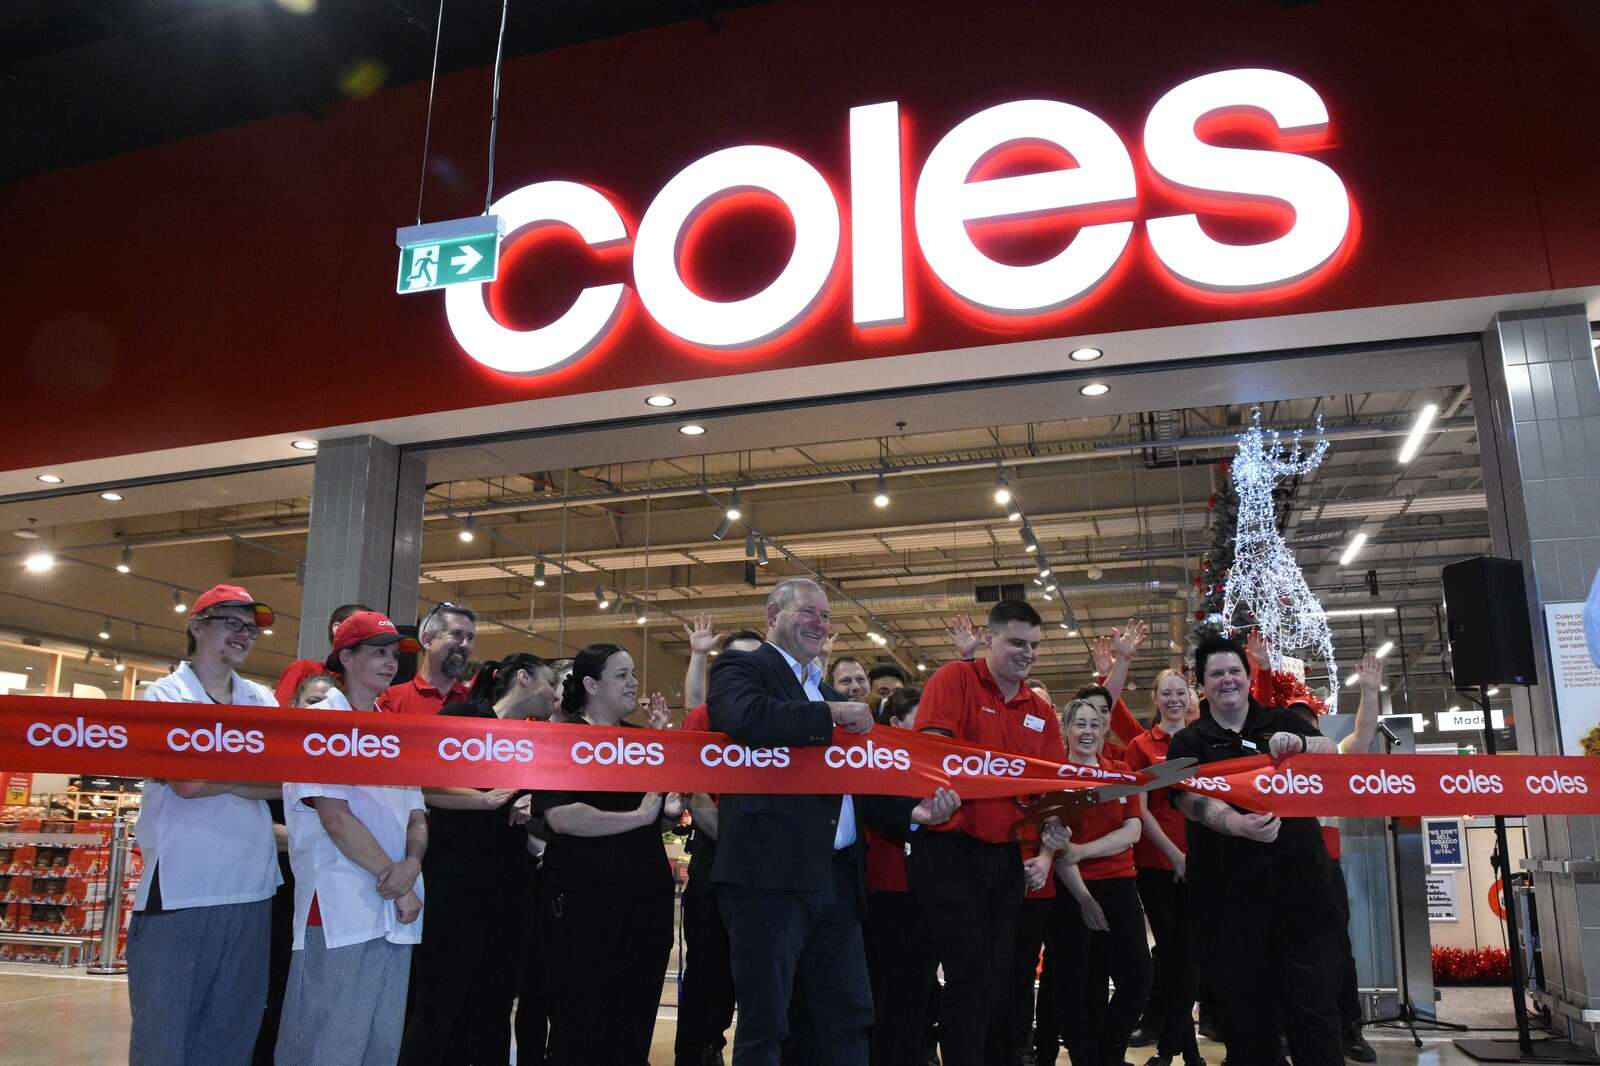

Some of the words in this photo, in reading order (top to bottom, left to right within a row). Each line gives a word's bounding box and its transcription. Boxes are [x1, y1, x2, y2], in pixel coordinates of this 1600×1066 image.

[446, 67, 1350, 374] coles
[27, 717, 128, 749] coles
[166, 723, 264, 753] coles
[303, 728, 400, 758] coles
[438, 733, 534, 763] coles
[571, 737, 665, 766] coles
[700, 743, 790, 768] coles
[824, 740, 911, 770] coles
[943, 751, 1026, 777] coles
[1254, 768, 1324, 795] coles
[1349, 768, 1416, 795] coles
[1439, 768, 1504, 794] coles
[1525, 769, 1589, 794] coles
